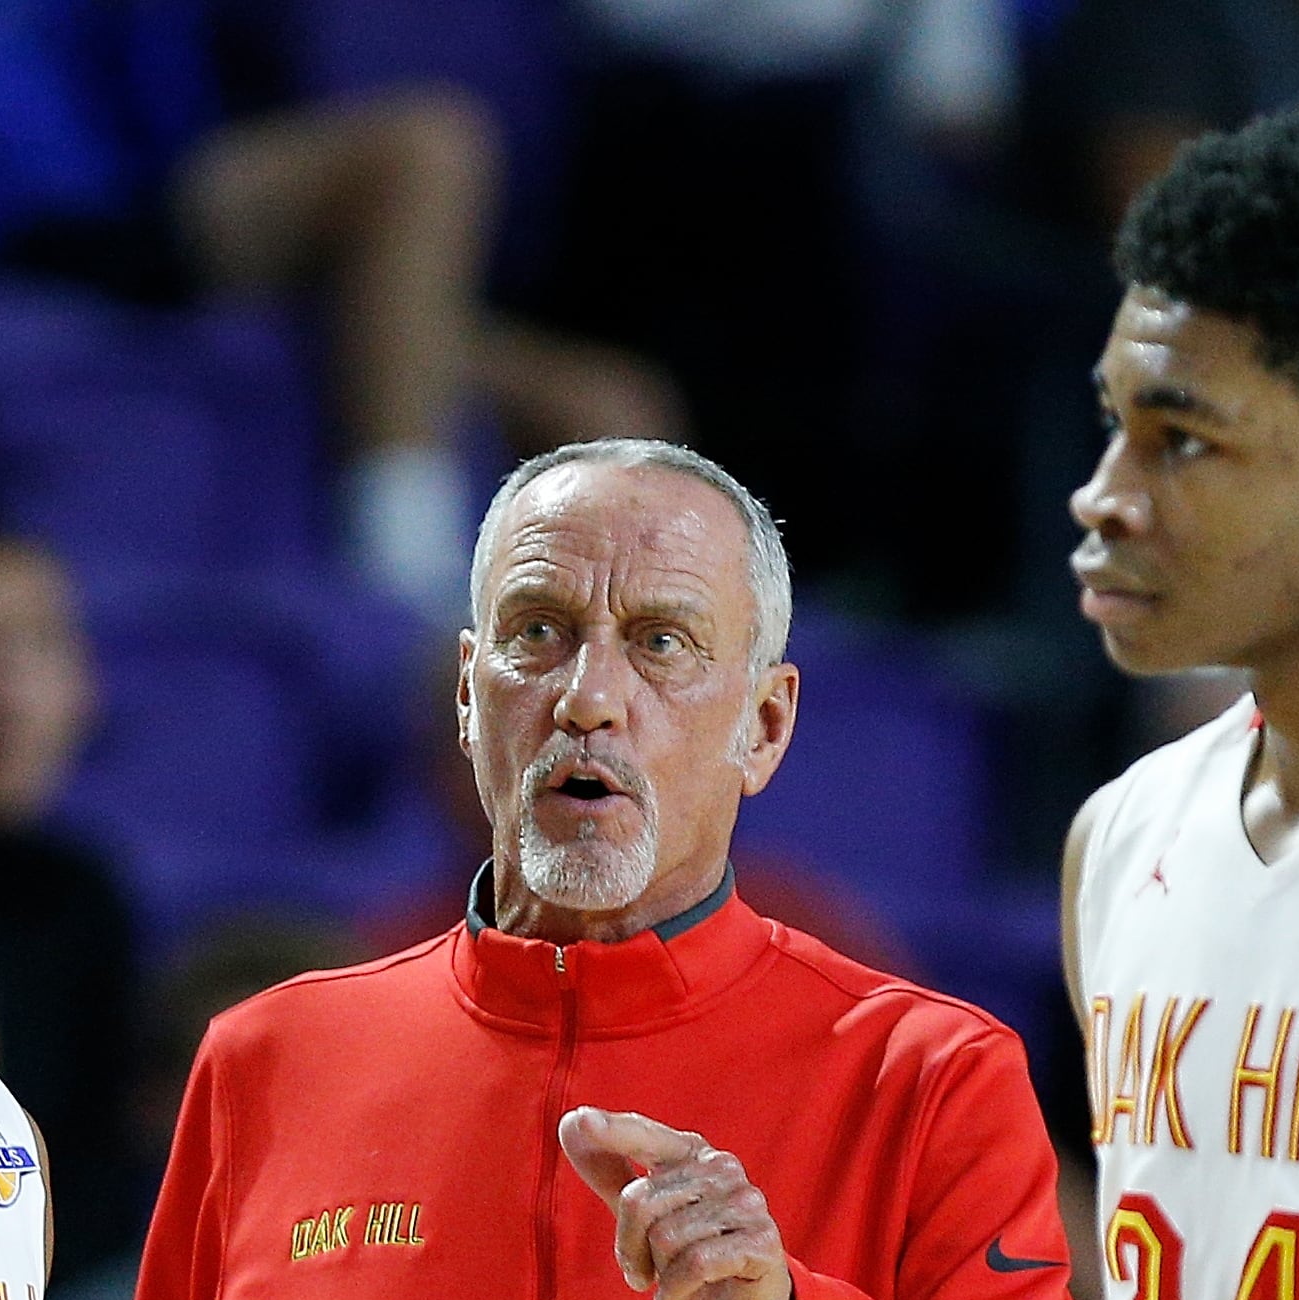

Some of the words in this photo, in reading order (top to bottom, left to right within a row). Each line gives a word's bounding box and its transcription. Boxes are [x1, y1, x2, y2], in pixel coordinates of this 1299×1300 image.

[1085, 992, 1213, 1151] OAK
[292, 1206, 355, 1262] OAK
[364, 1203, 426, 1245] HILL
